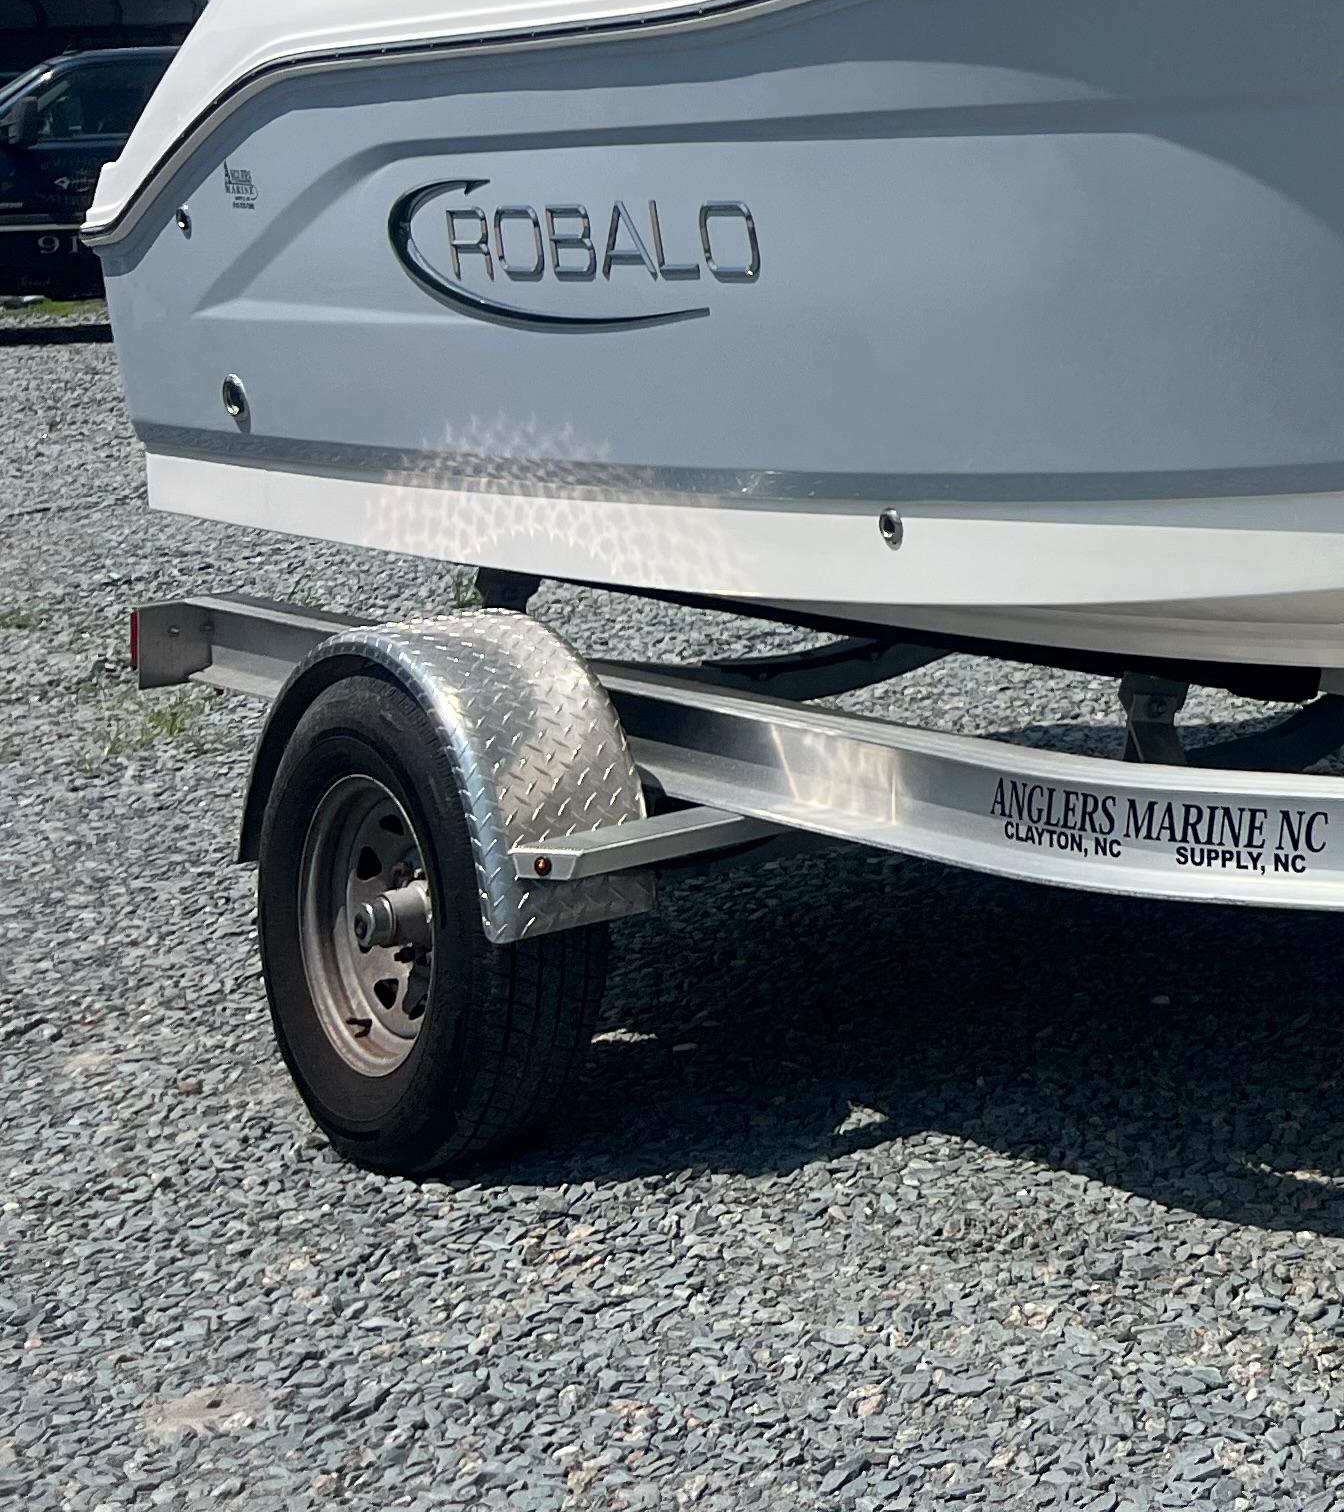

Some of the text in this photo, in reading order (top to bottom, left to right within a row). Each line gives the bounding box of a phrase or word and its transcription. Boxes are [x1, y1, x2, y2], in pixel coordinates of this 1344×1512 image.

[446, 199, 762, 284] ROBALO
[990, 776, 1330, 854] ANGLERS MARINE NC
[1004, 820, 1122, 859] CLAYTON, NC
[1175, 846, 1306, 876] SUPPLY, NC
